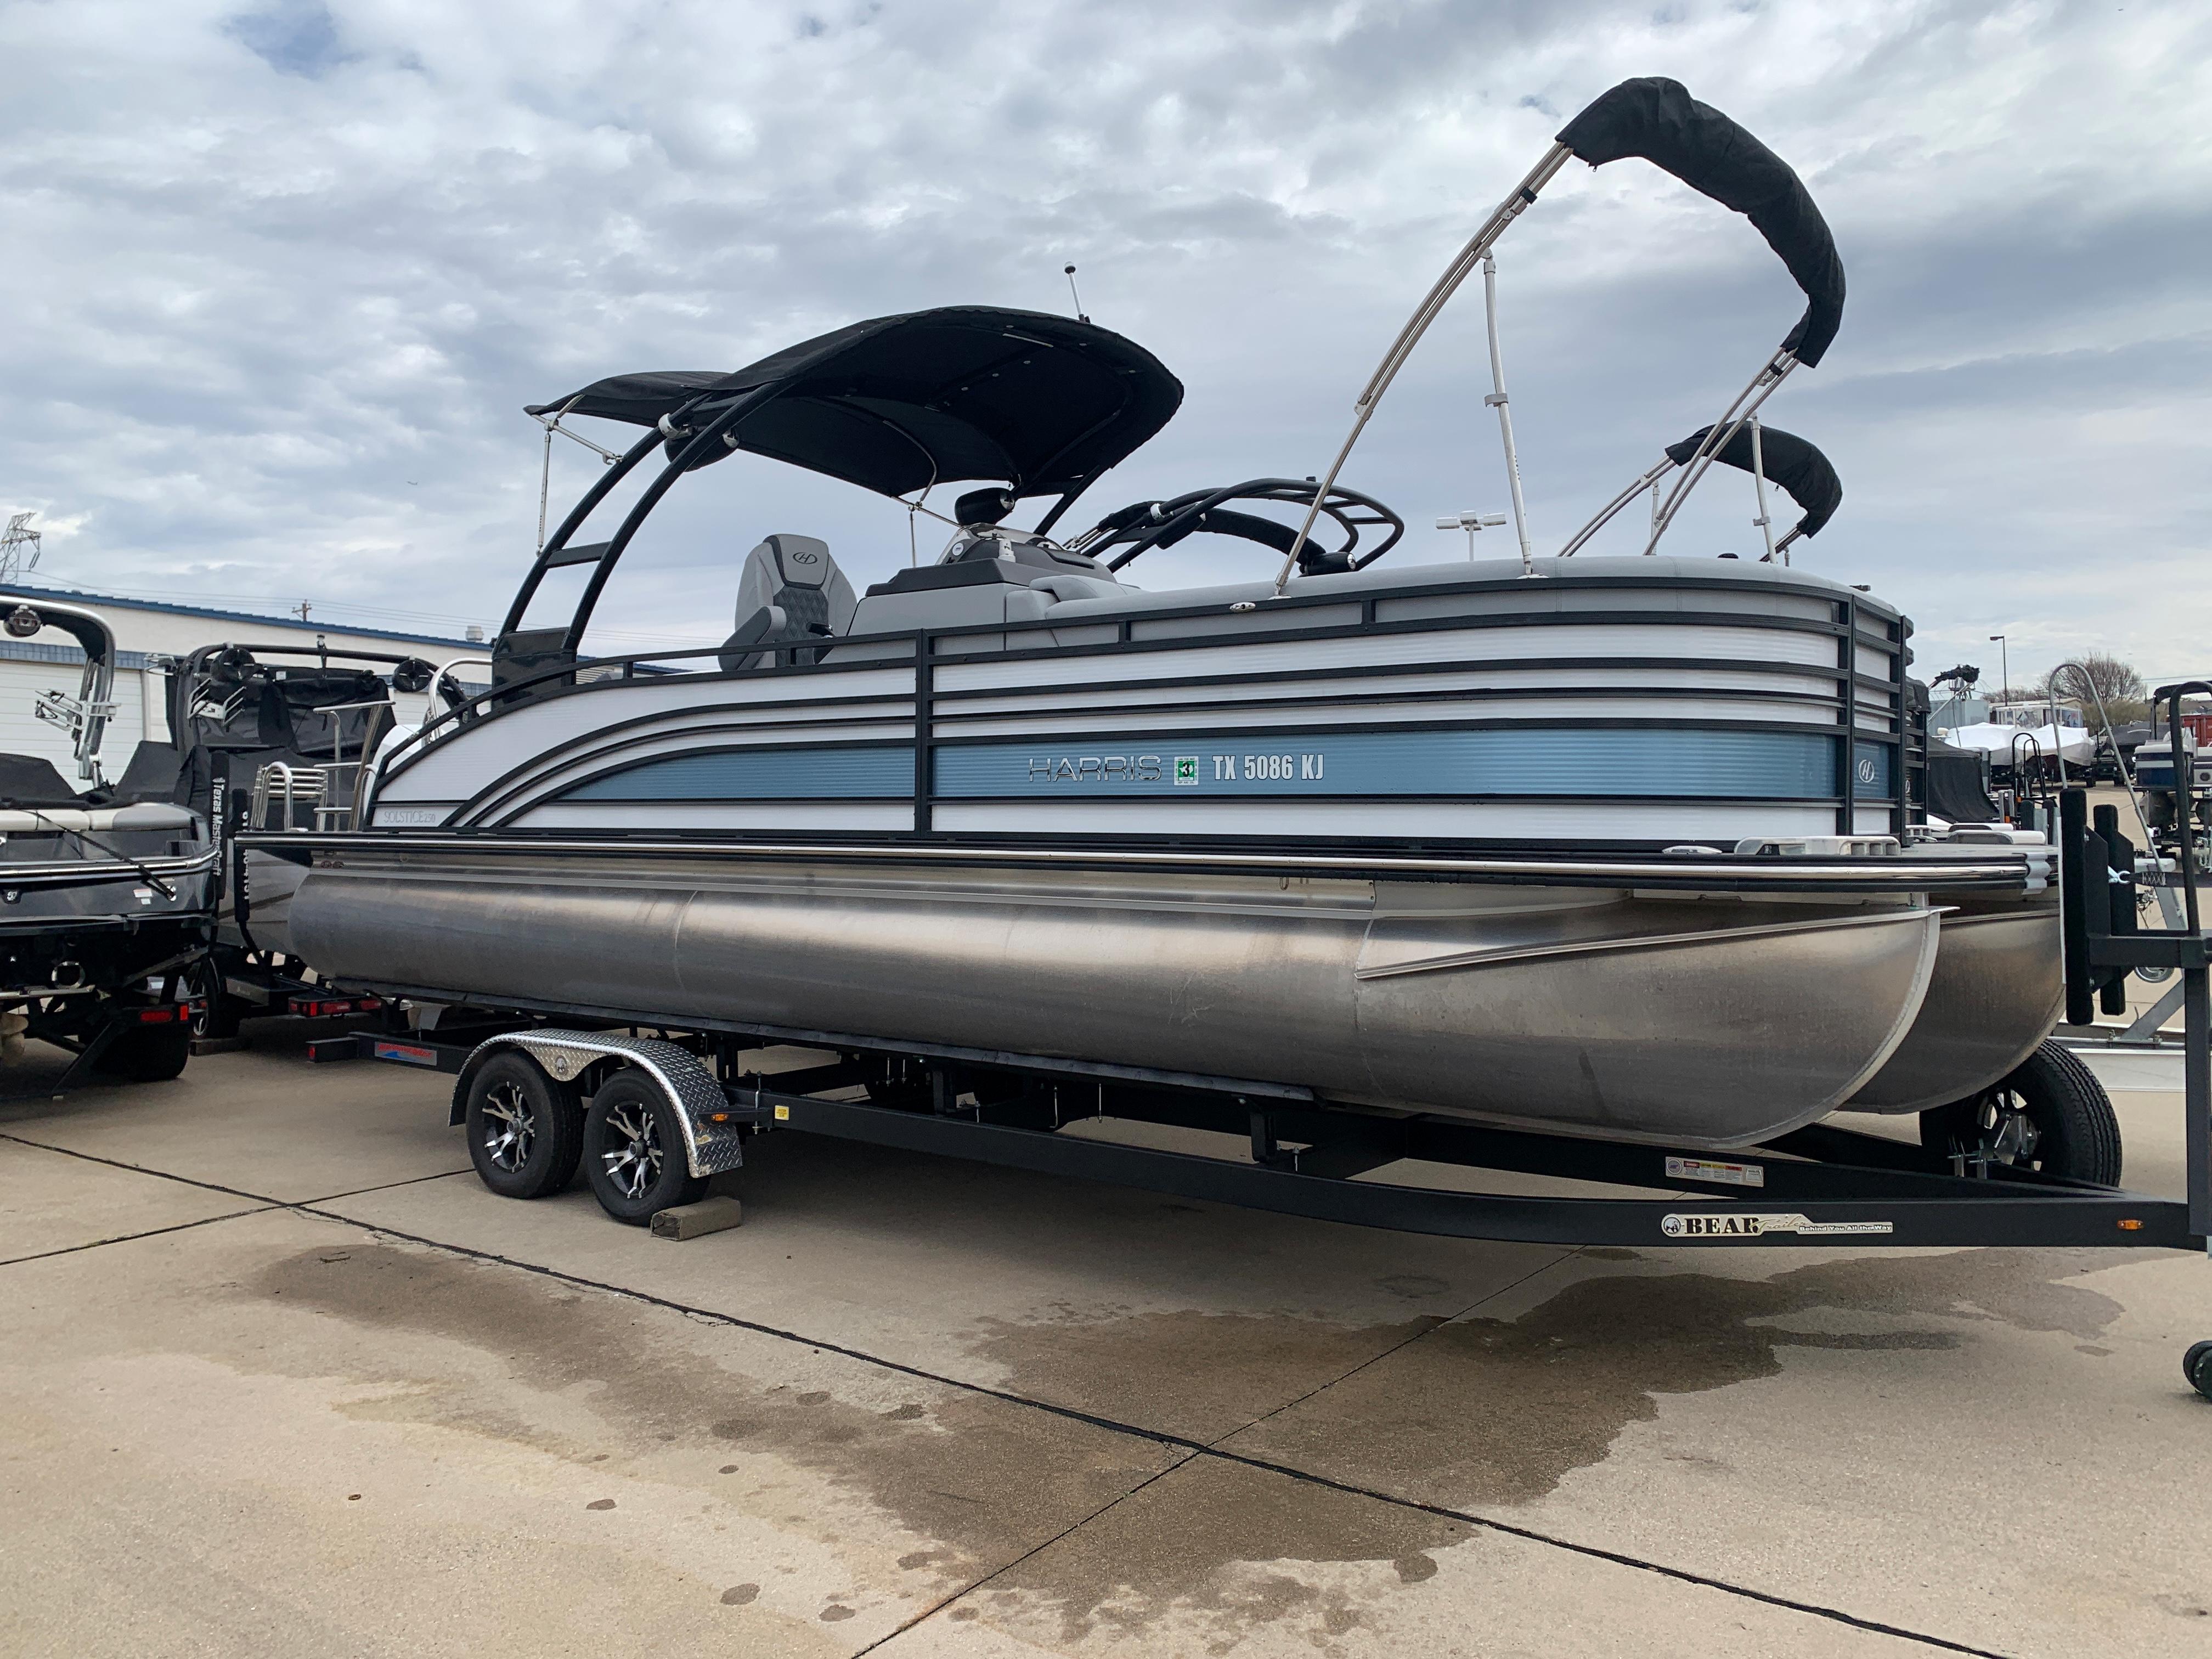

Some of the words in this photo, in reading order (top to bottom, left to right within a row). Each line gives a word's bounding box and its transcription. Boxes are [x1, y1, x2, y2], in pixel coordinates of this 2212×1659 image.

[1029, 755, 1162, 782] HARRIS
[1182, 762, 1190, 777] 3
[1212, 755, 1237, 780] TX
[1244, 754, 1294, 780] 5086
[1301, 754, 1324, 780] KJ
[213, 785, 224, 812] Texas
[384, 811, 424, 823] SOLSTICE
[424, 814, 436, 822] 250
[1684, 1217, 1760, 1234] BEAR
